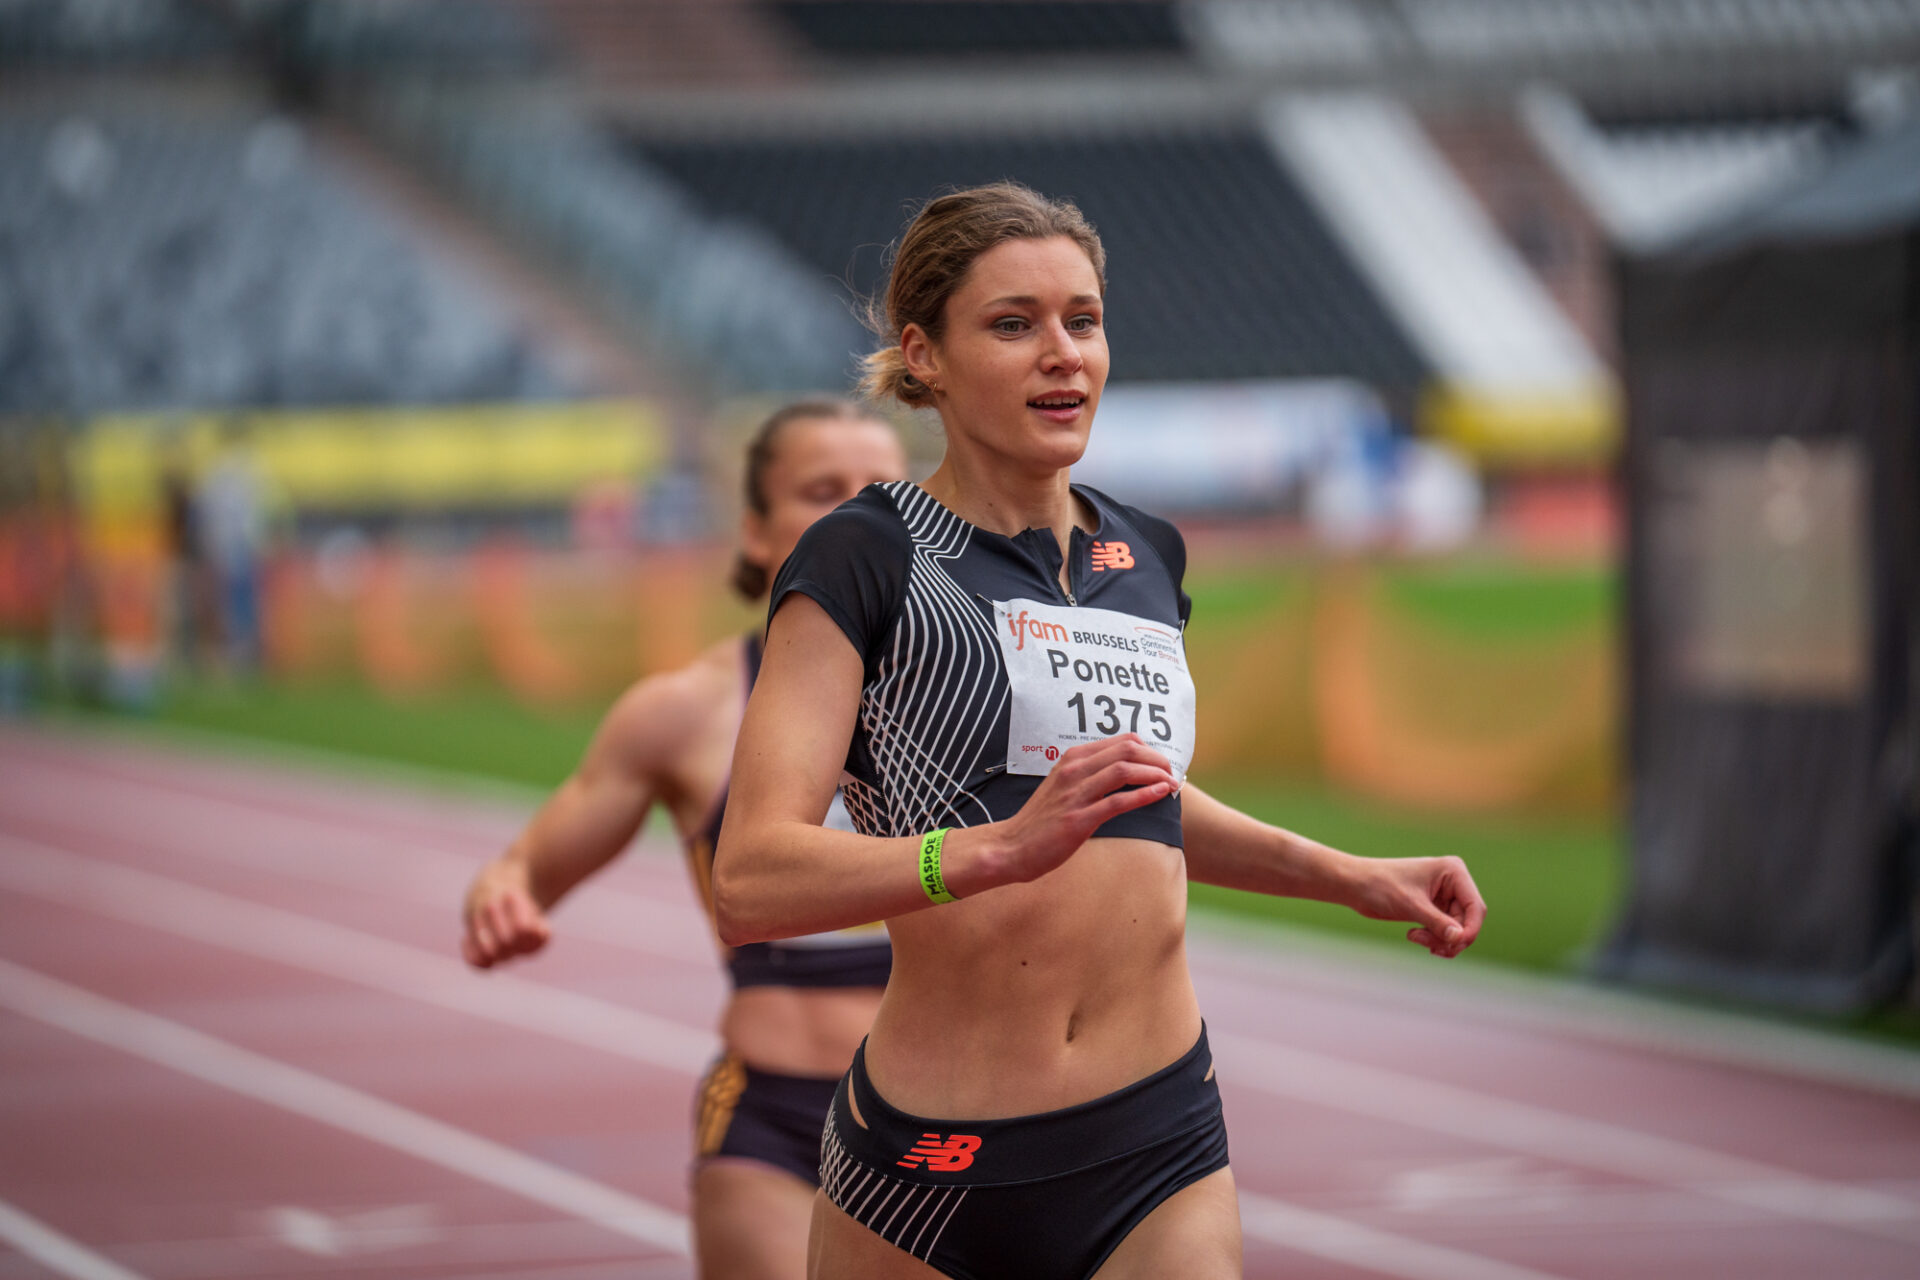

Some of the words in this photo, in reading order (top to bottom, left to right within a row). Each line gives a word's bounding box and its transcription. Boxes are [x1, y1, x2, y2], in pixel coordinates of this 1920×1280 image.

[1007, 610, 1069, 651] ifam
[1072, 631, 1139, 652] BRUSSELS
[1047, 648, 1170, 695] Ponette
[1067, 692, 1171, 742] 1375
[1021, 745, 1044, 753] sport
[924, 837, 940, 896] MASPOE
[896, 1132, 982, 1172] NB
